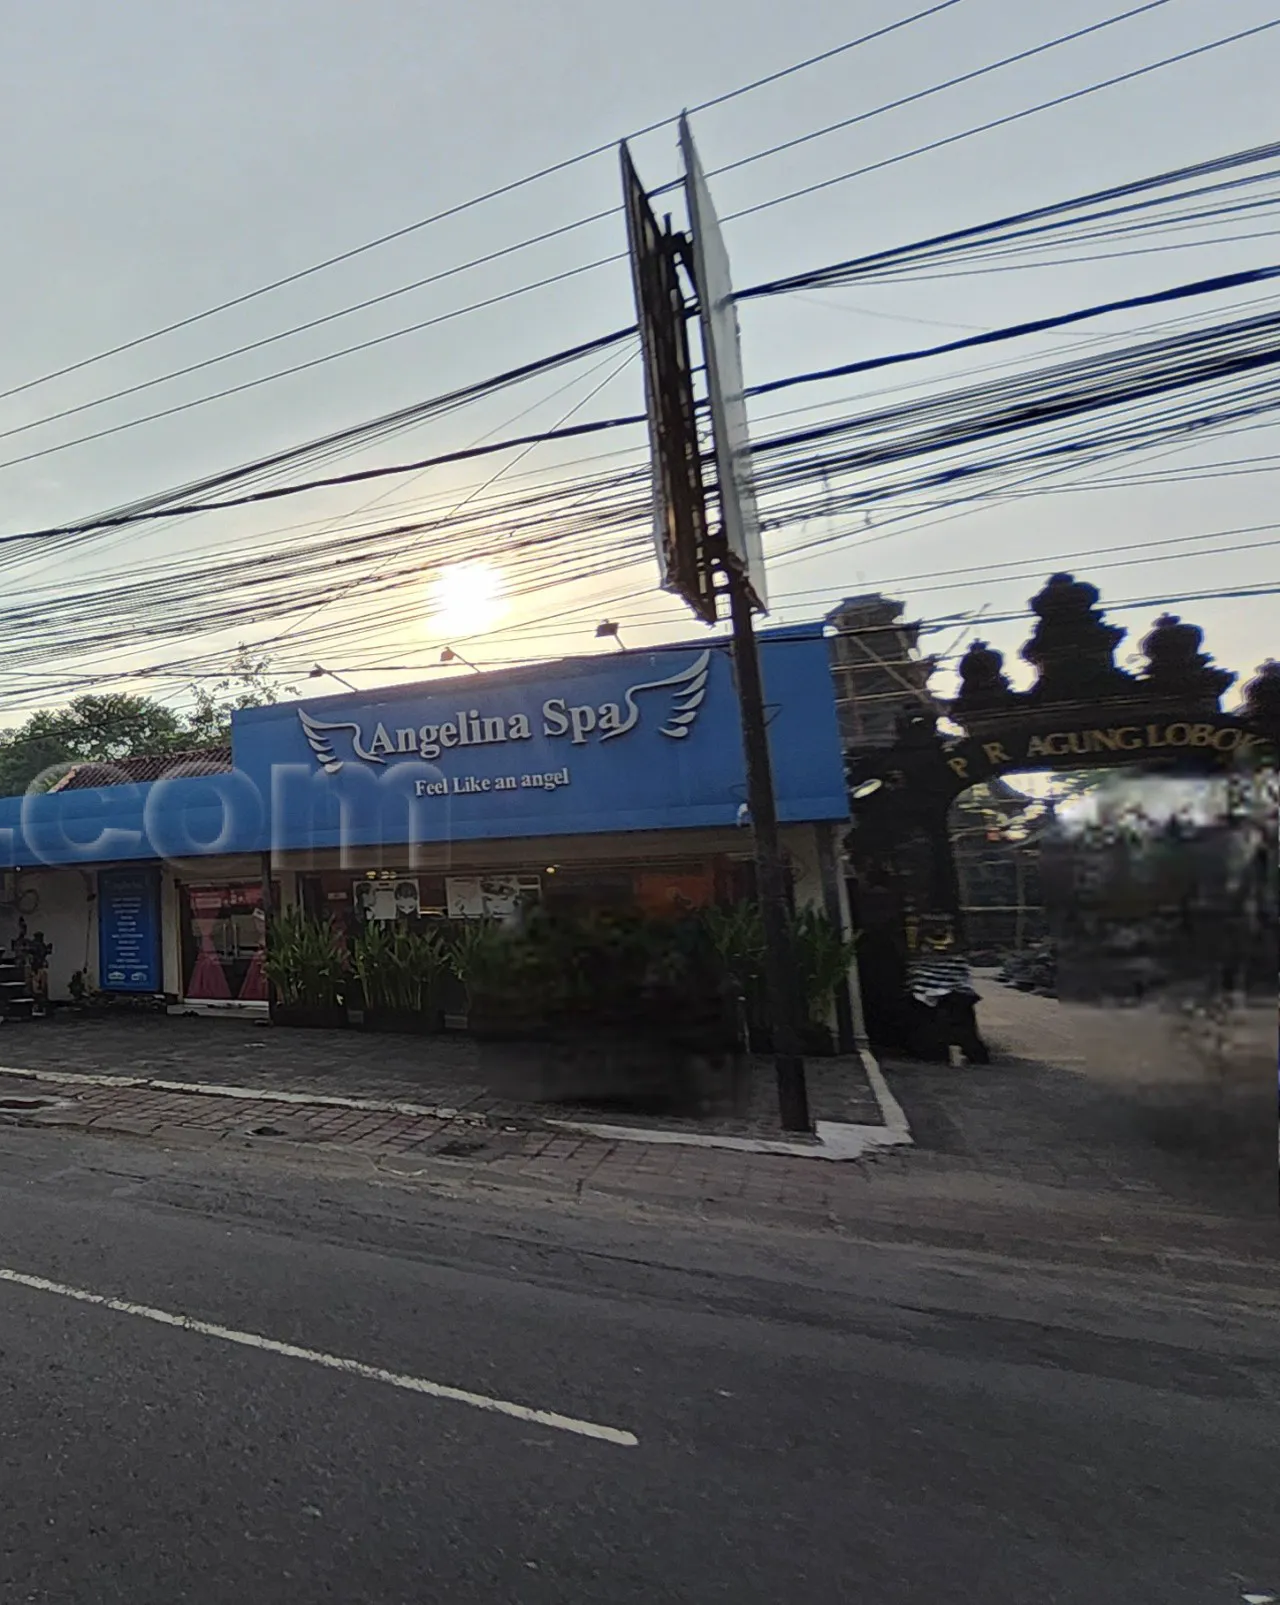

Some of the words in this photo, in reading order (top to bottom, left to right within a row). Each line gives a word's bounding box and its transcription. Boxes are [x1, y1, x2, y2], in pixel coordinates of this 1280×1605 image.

[369, 709, 531, 759] Angelina
[542, 698, 621, 745] Spa
[1026, 727, 1144, 757] AGUNG
[415, 780, 449, 798] Feel
[453, 776, 491, 794] Like
[495, 775, 517, 790] an
[520, 767, 570, 790] angel
